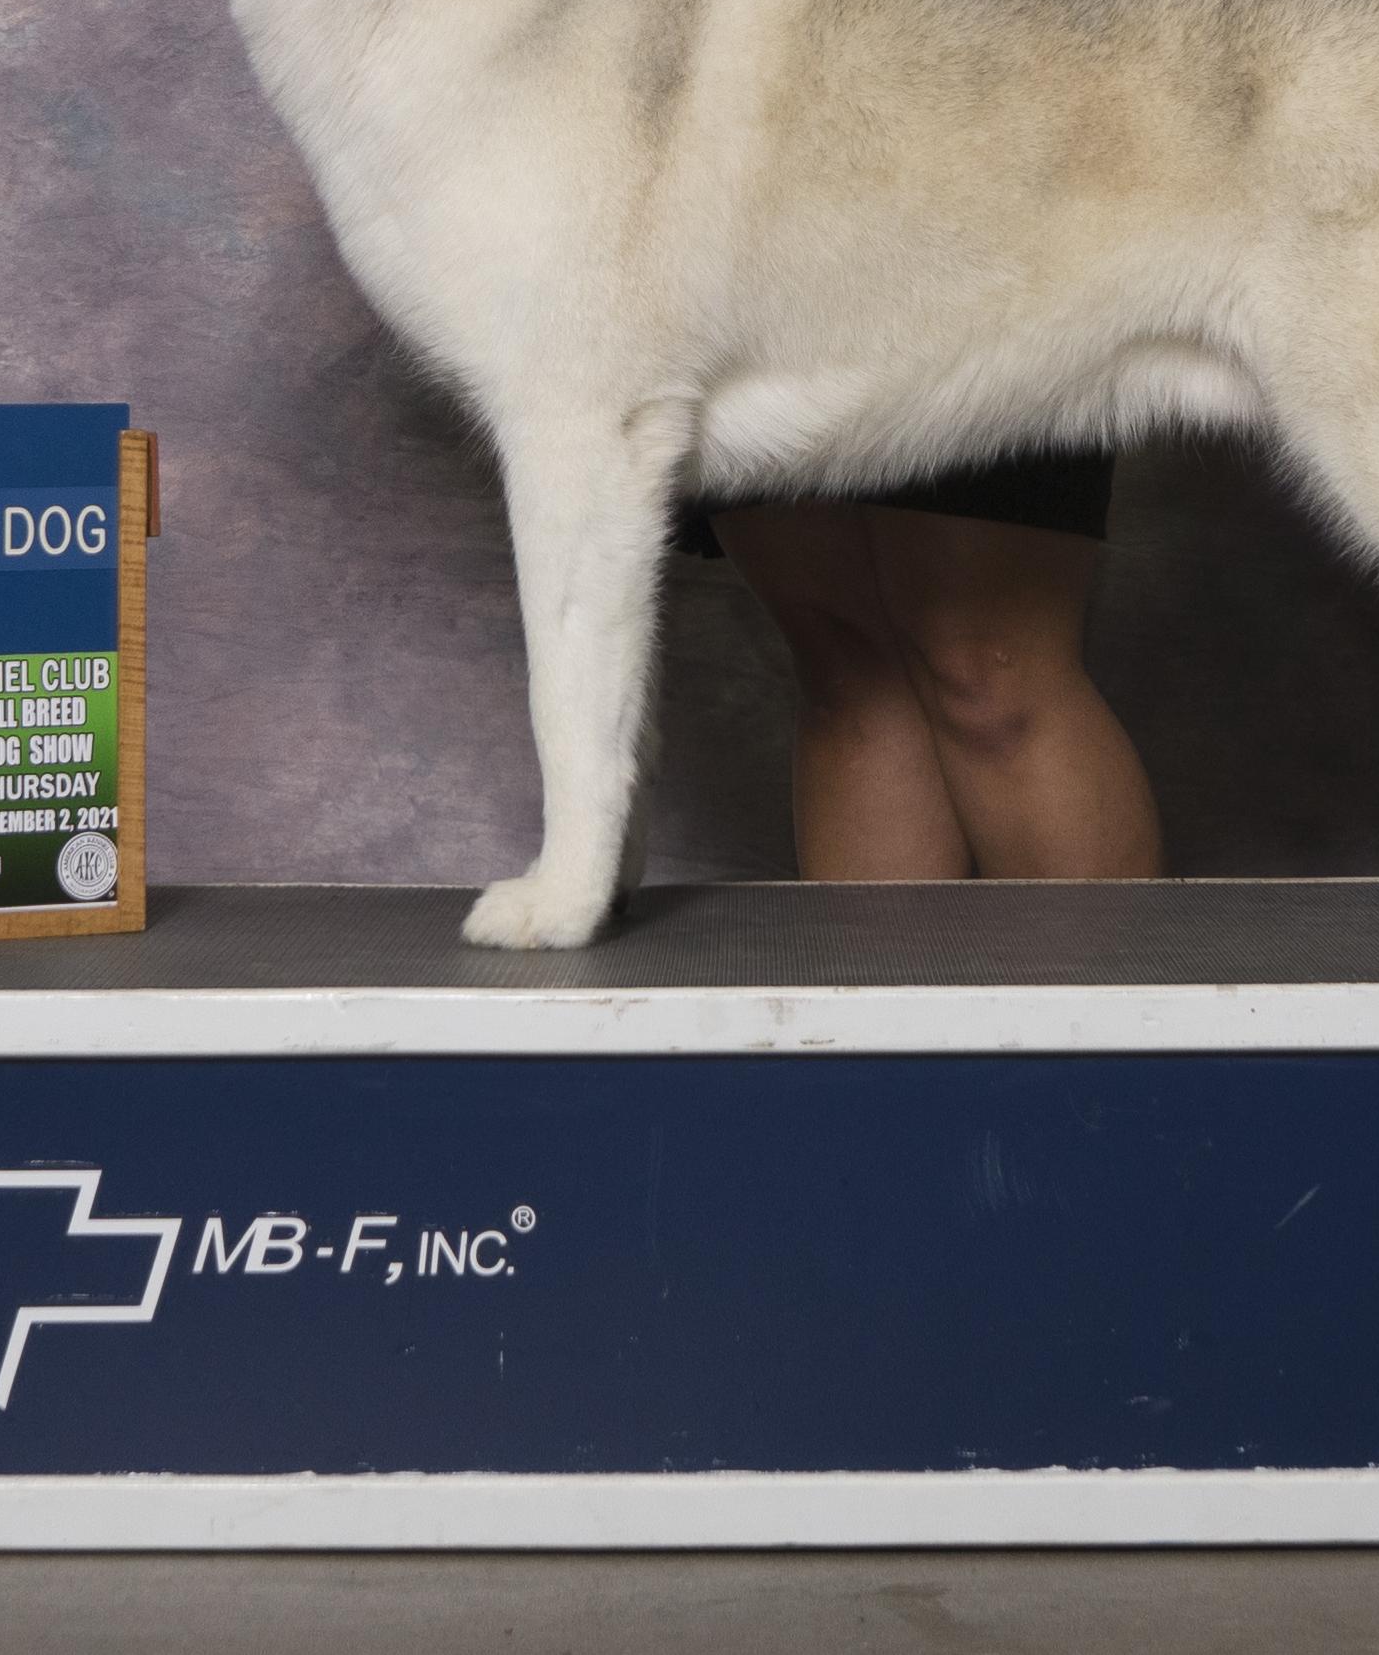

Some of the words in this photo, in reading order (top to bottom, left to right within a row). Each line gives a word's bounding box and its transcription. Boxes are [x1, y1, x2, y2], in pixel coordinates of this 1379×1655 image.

[3, 504, 107, 556] DOG
[40, 656, 111, 691] CLUB
[22, 696, 87, 728] BREED
[29, 733, 94, 765] SHOW
[59, 808, 74, 833] 2,
[77, 806, 118, 831] 2021
